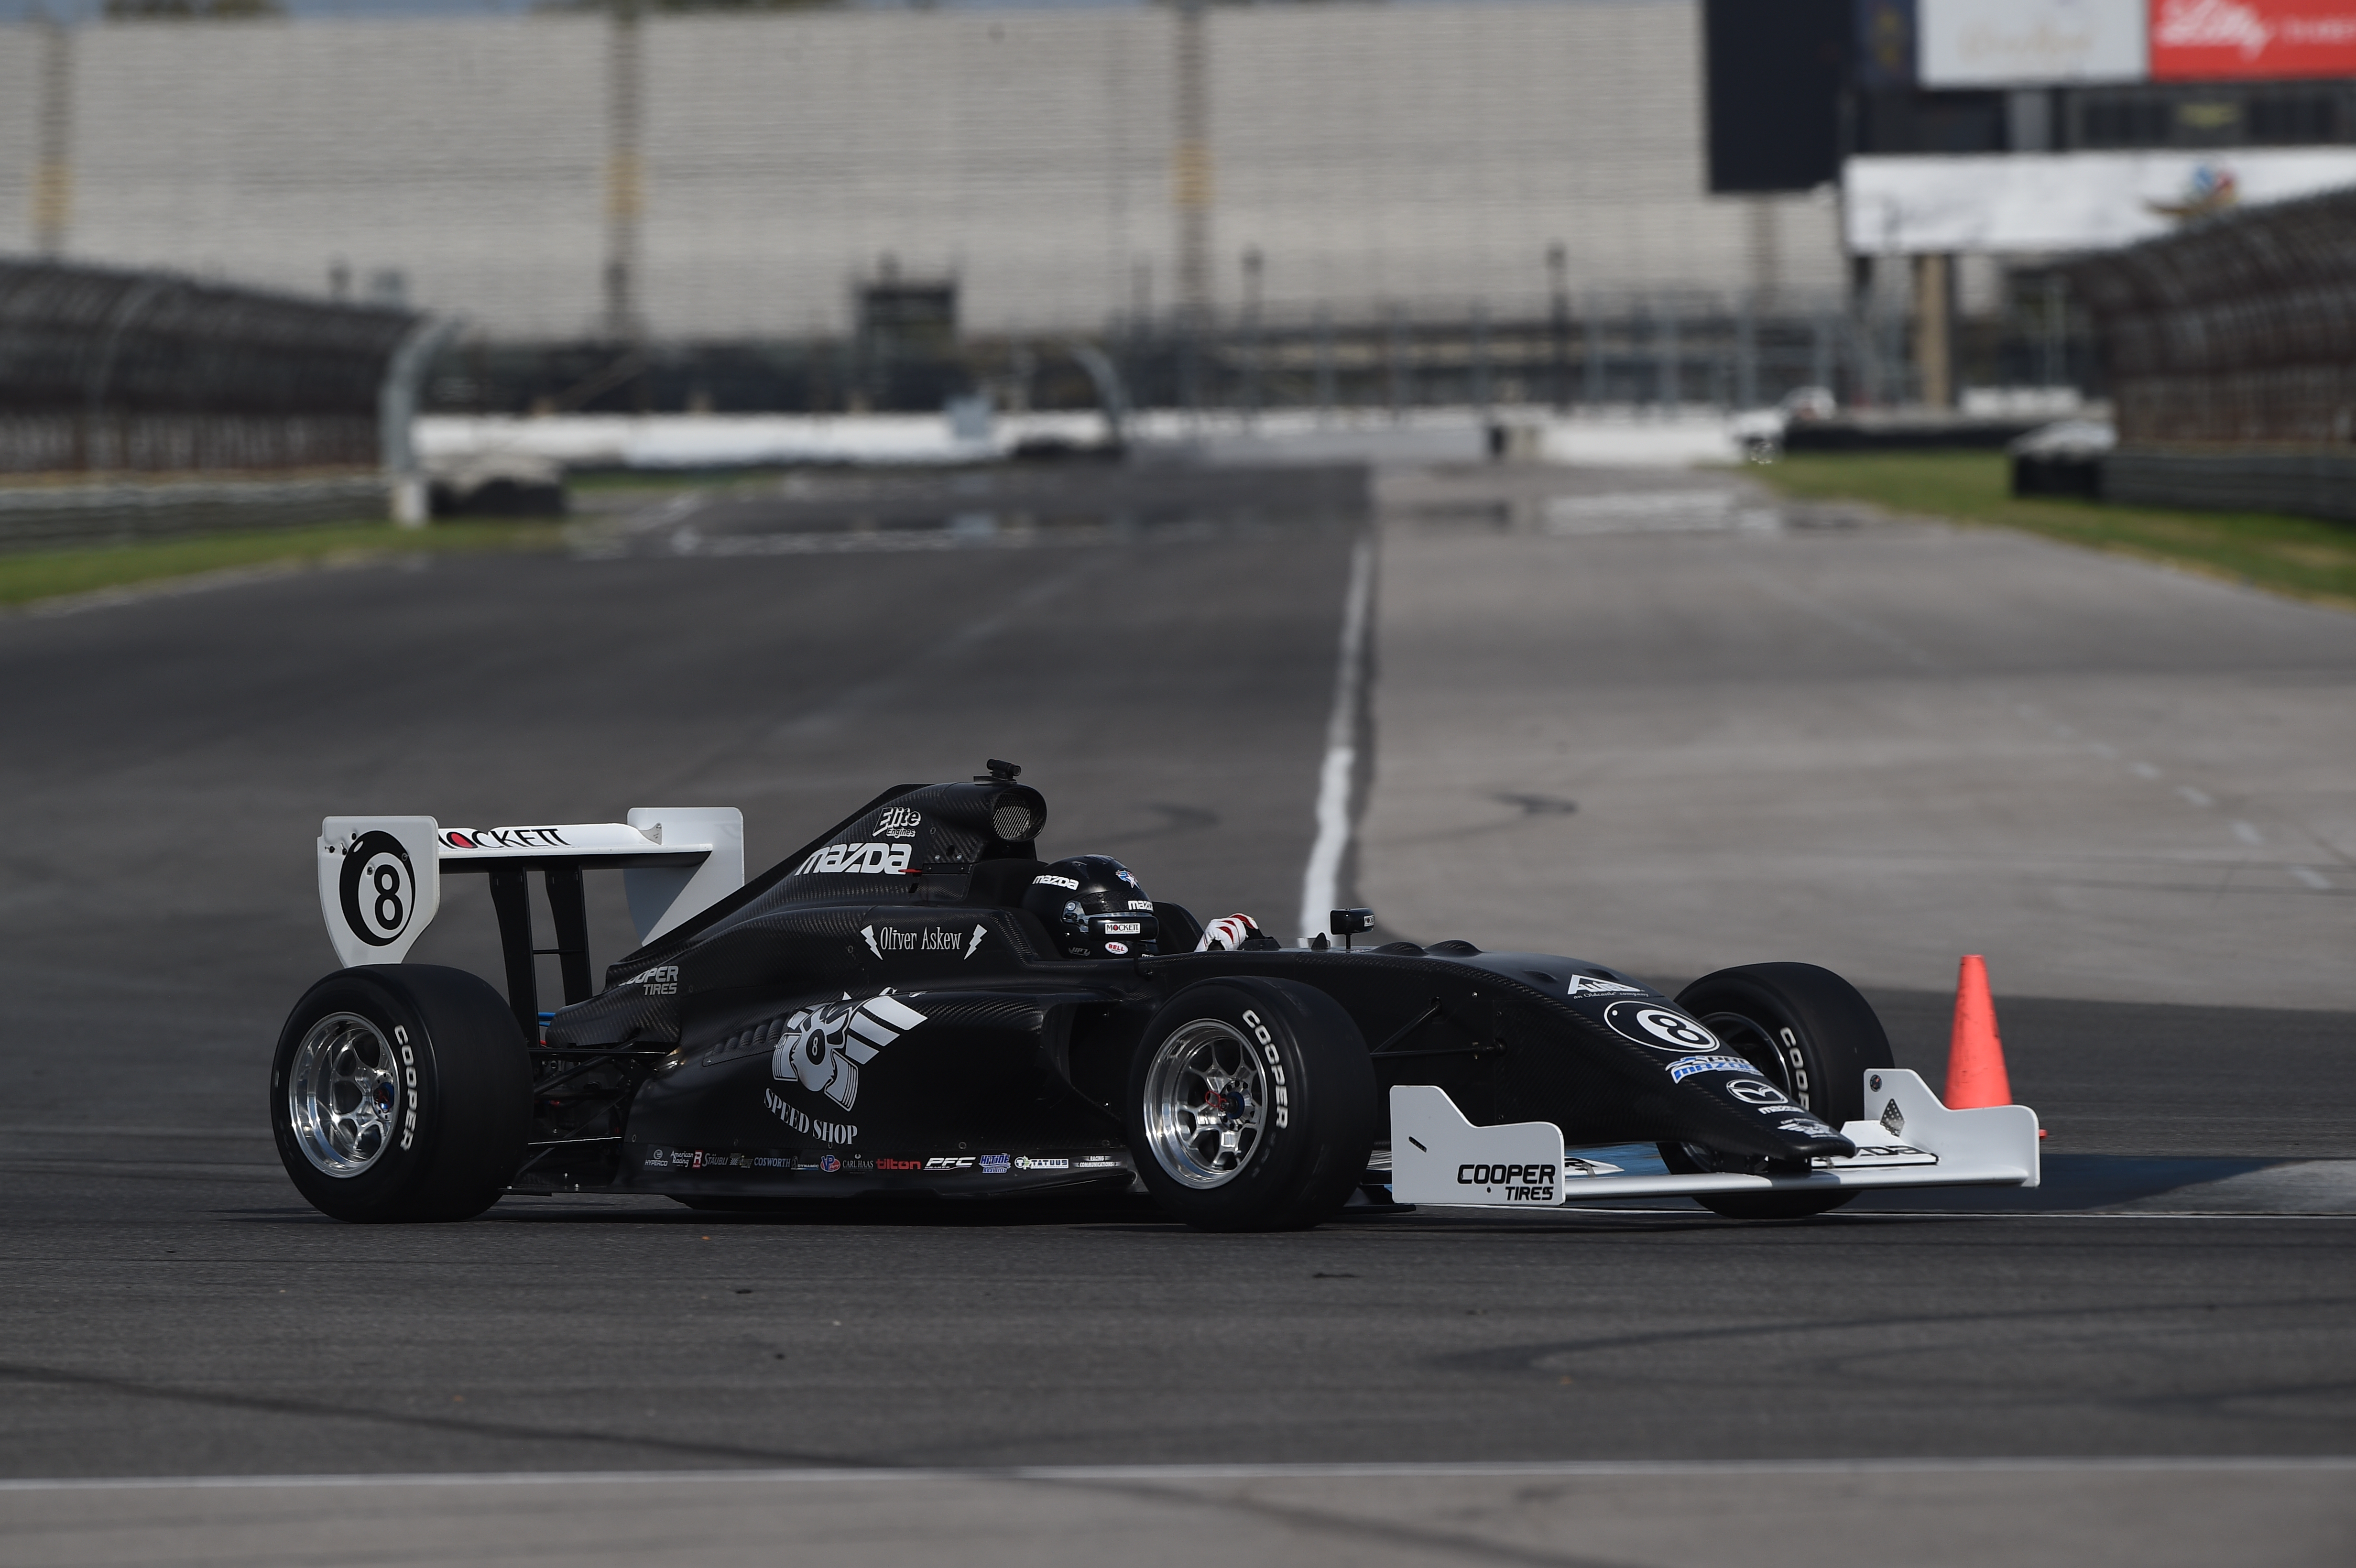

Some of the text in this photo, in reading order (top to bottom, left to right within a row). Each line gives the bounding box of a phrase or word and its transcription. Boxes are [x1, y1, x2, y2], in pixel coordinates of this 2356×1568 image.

[873, 807, 921, 837] Elite
[438, 828, 572, 849] OCKETT
[886, 828, 916, 838] Engines
[374, 864, 403, 930] 8
[881, 927, 962, 950] Oliver Askew
[644, 983, 677, 995] TIRES
[1648, 1014, 1711, 1045] 8
[812, 1036, 818, 1056] 8
[1243, 1010, 1288, 1129] COOPER
[1780, 1027, 1810, 1111] COOP
[394, 1025, 417, 1151] COOPER
[764, 1088, 858, 1144] SPEED SHOP
[672, 1157, 689, 1167] Racing
[754, 1157, 791, 1166] COSWORTH
[821, 1155, 835, 1171] VP
[876, 1159, 921, 1169] tilton
[926, 1157, 976, 1166] PFC
[1458, 1165, 1556, 1184] COOPER
[1505, 1187, 1553, 1200] TIRES
